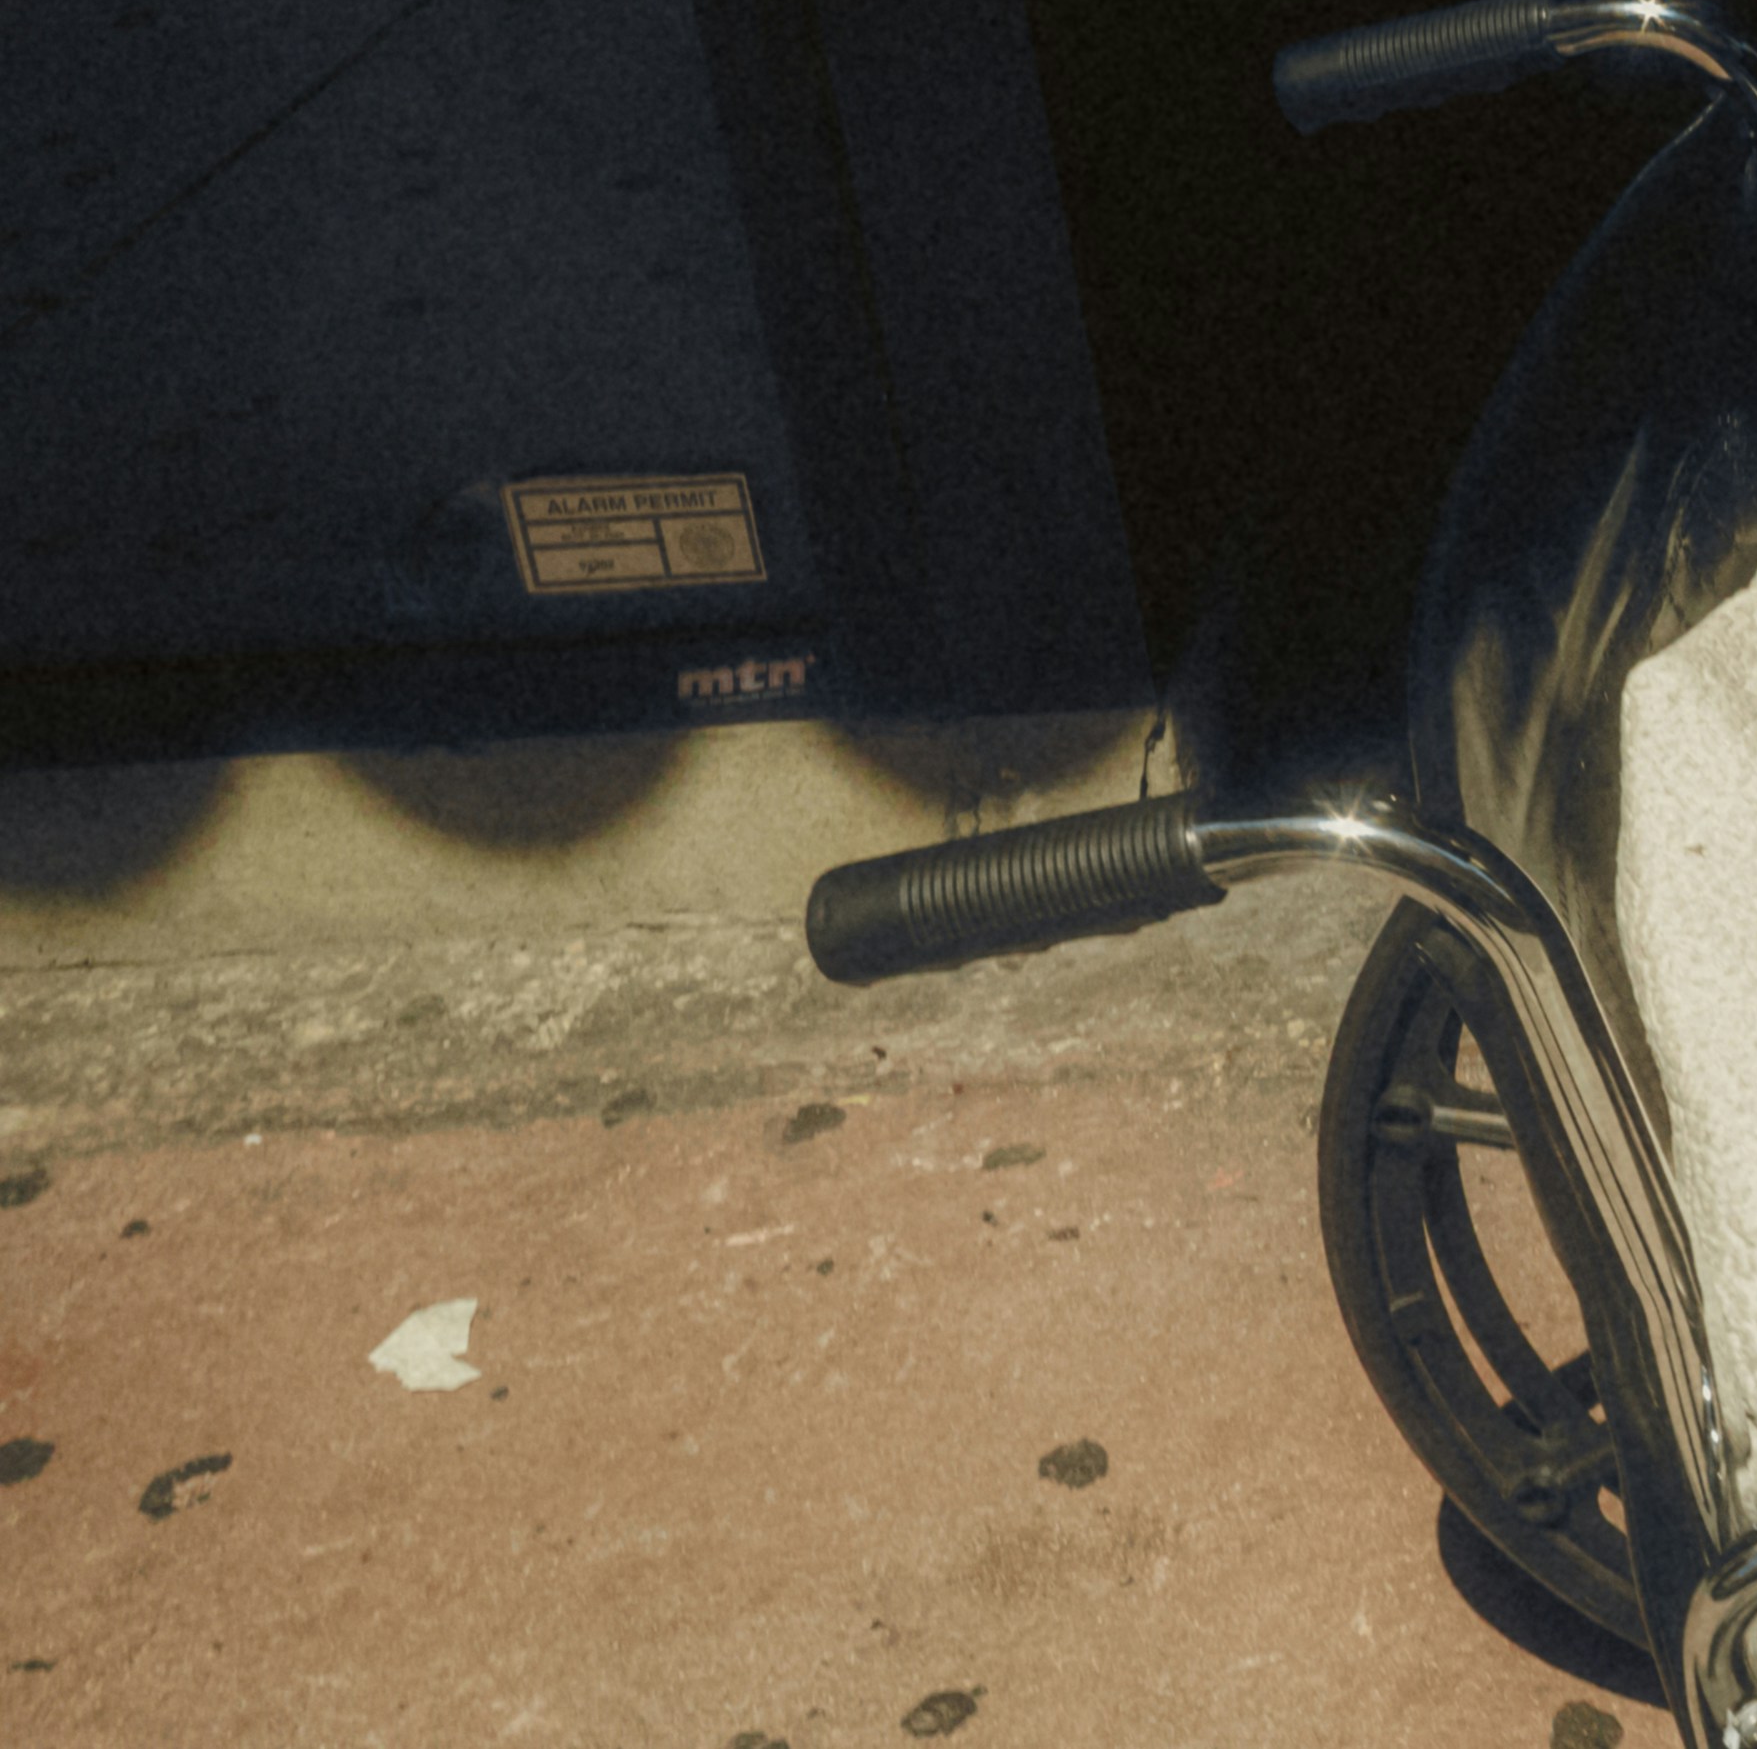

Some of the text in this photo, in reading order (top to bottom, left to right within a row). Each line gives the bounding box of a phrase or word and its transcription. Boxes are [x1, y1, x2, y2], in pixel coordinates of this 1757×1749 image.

[547, 489, 718, 517] ALARM PERMIT
[677, 657, 807, 700] mtn
